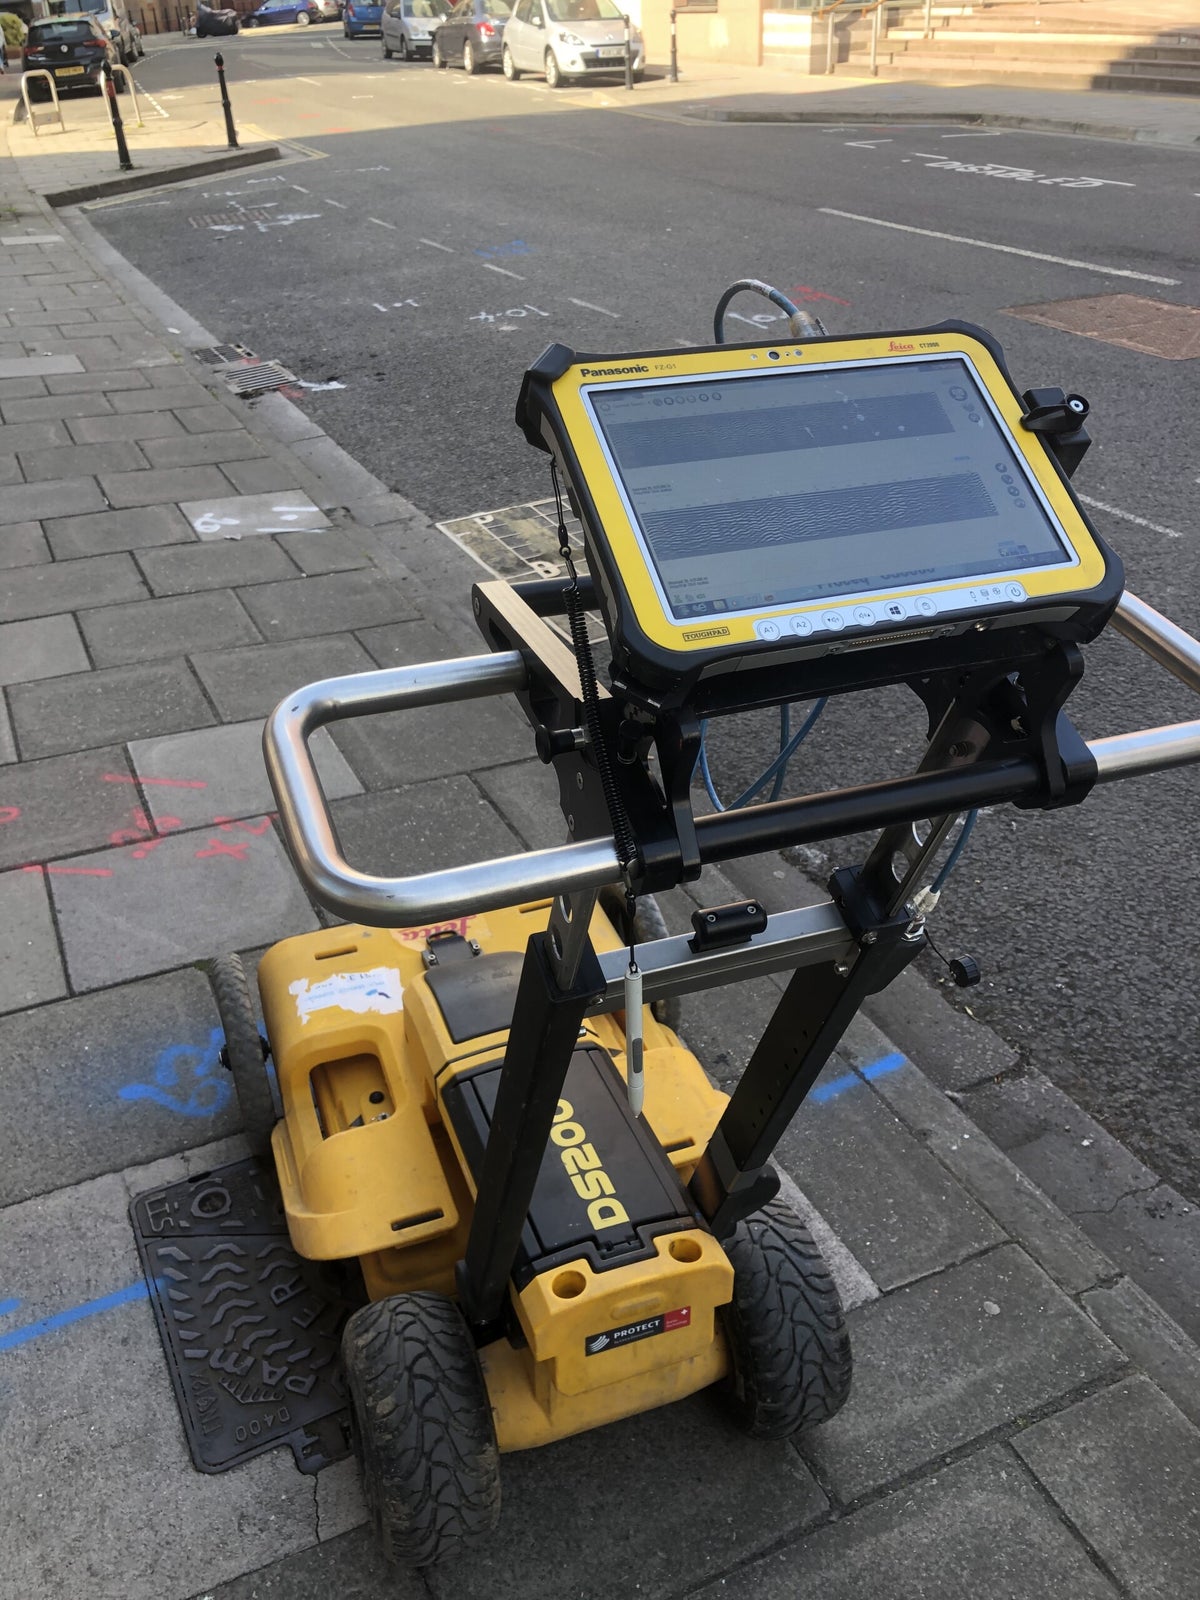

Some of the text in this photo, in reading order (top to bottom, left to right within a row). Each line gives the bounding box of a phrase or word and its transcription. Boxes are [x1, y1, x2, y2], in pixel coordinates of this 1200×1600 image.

[924, 161, 1105, 188] DISABLED
[888, 341, 915, 352] Leica
[580, 363, 677, 377] Panasonic FZ-G1
[684, 627, 729, 640] TOUGHPAD
[613, 1320, 661, 1339] PROTECT
[235, 1406, 290, 1441] D400
